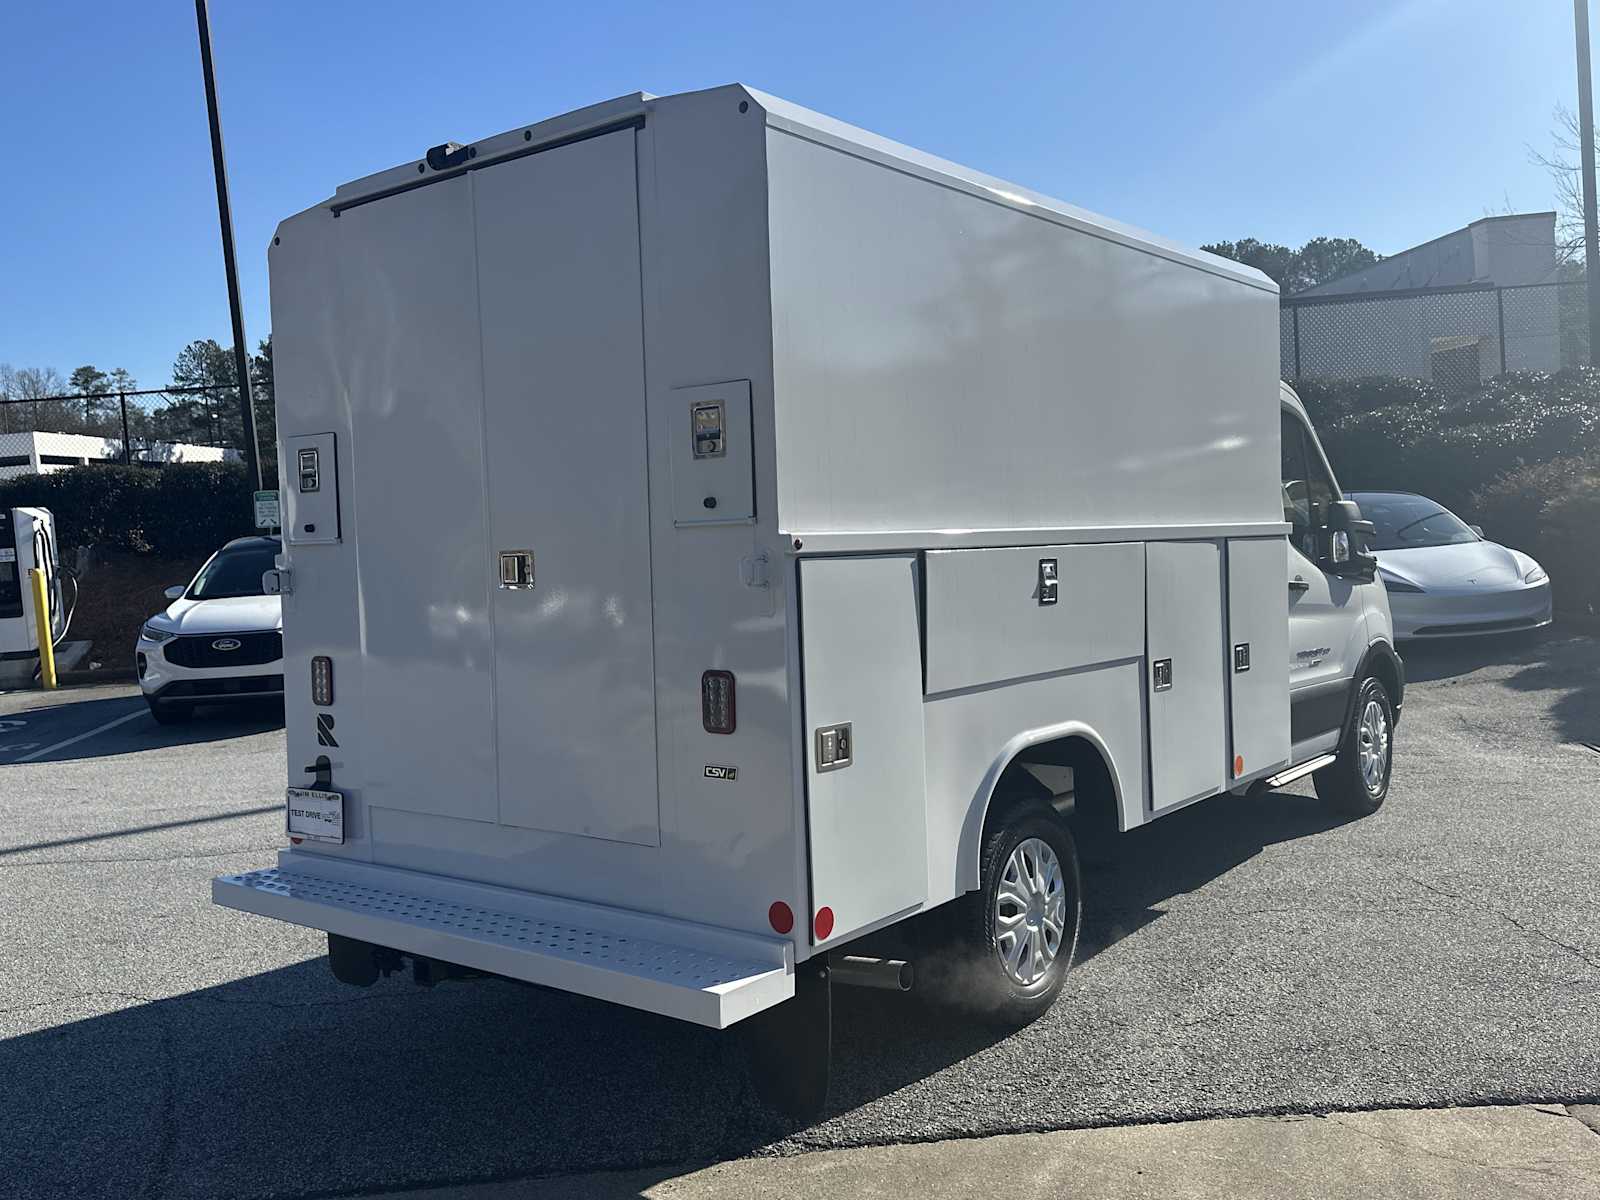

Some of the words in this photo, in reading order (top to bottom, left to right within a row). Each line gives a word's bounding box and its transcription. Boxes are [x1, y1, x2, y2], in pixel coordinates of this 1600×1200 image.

[317, 713, 340, 748] R
[705, 767, 726, 778] CSV
[290, 809, 304, 817] TEST
[305, 810, 321, 820] DRIVE
